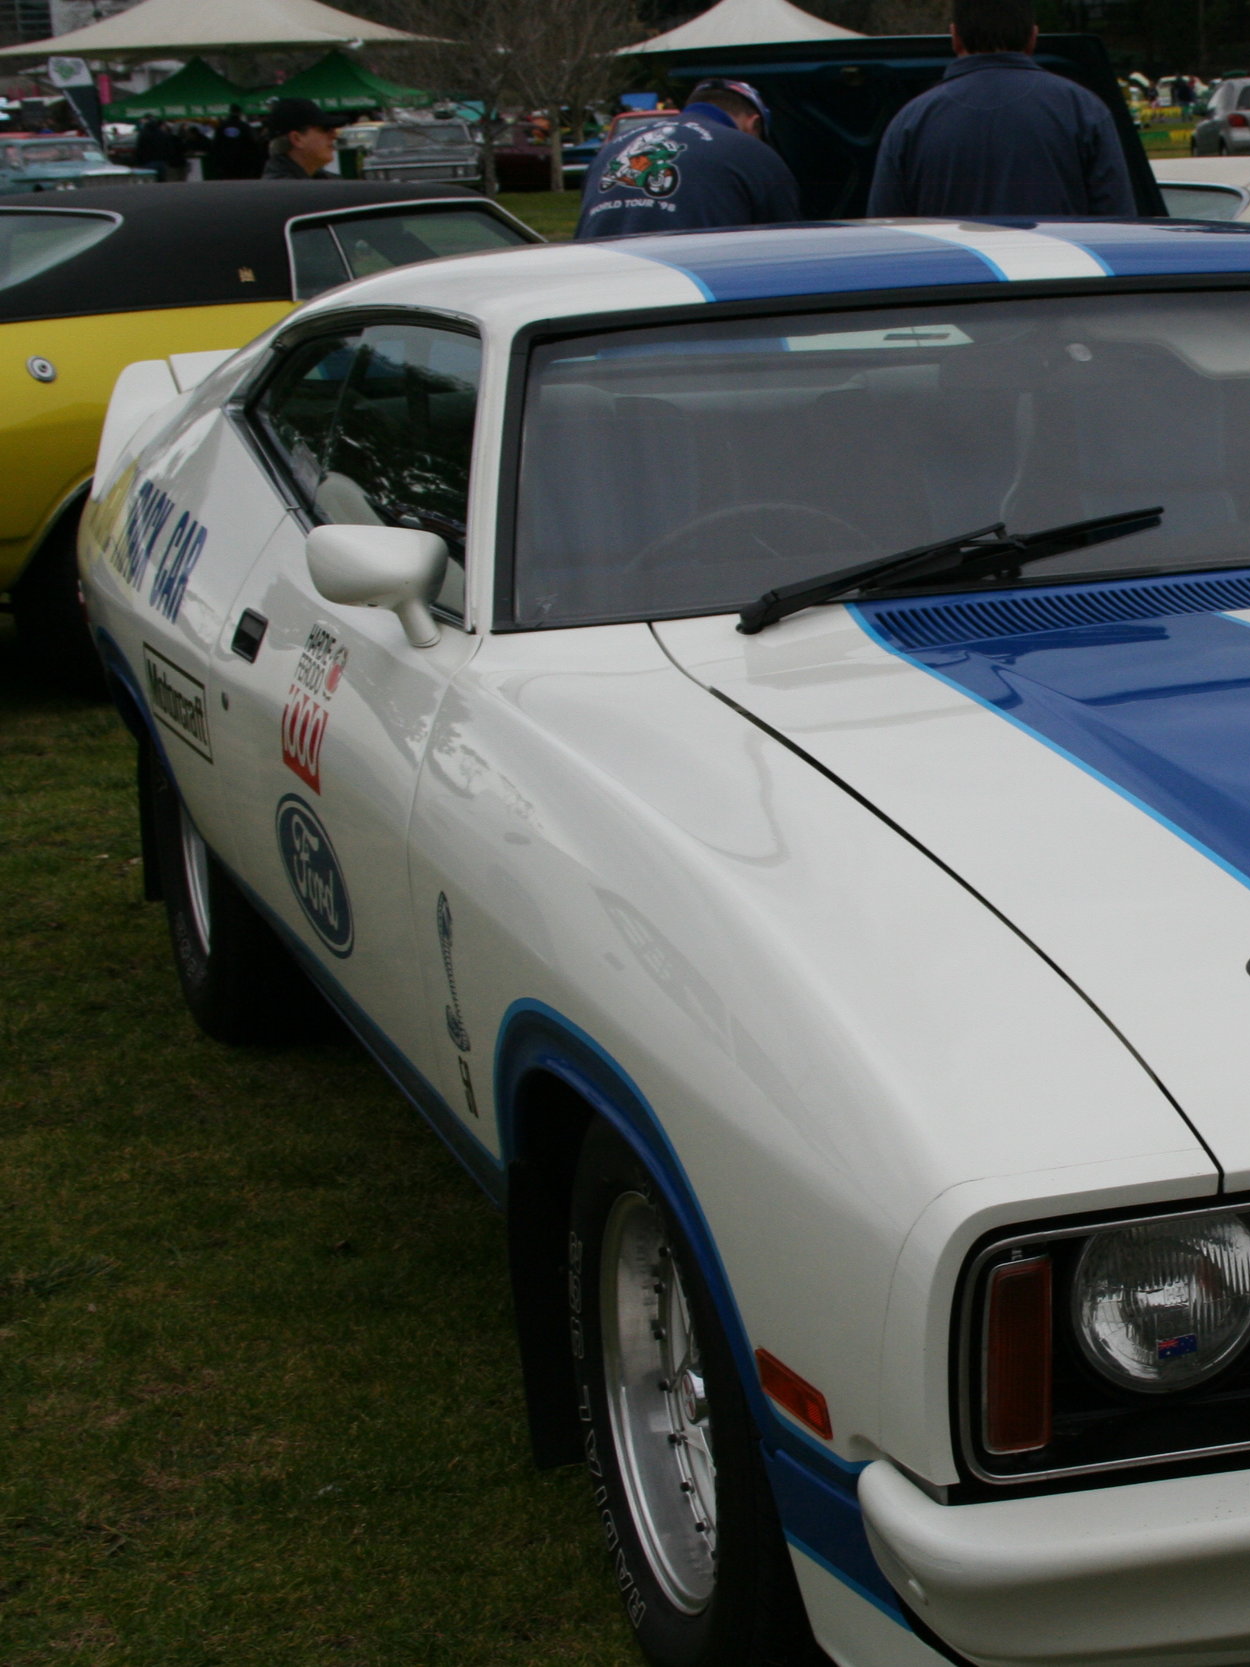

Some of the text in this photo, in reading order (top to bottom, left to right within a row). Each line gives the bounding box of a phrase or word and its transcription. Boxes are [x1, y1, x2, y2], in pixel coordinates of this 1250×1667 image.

[625, 199, 654, 208] TOUR
[149, 510, 208, 624] CAR
[291, 812, 339, 931] Ford
